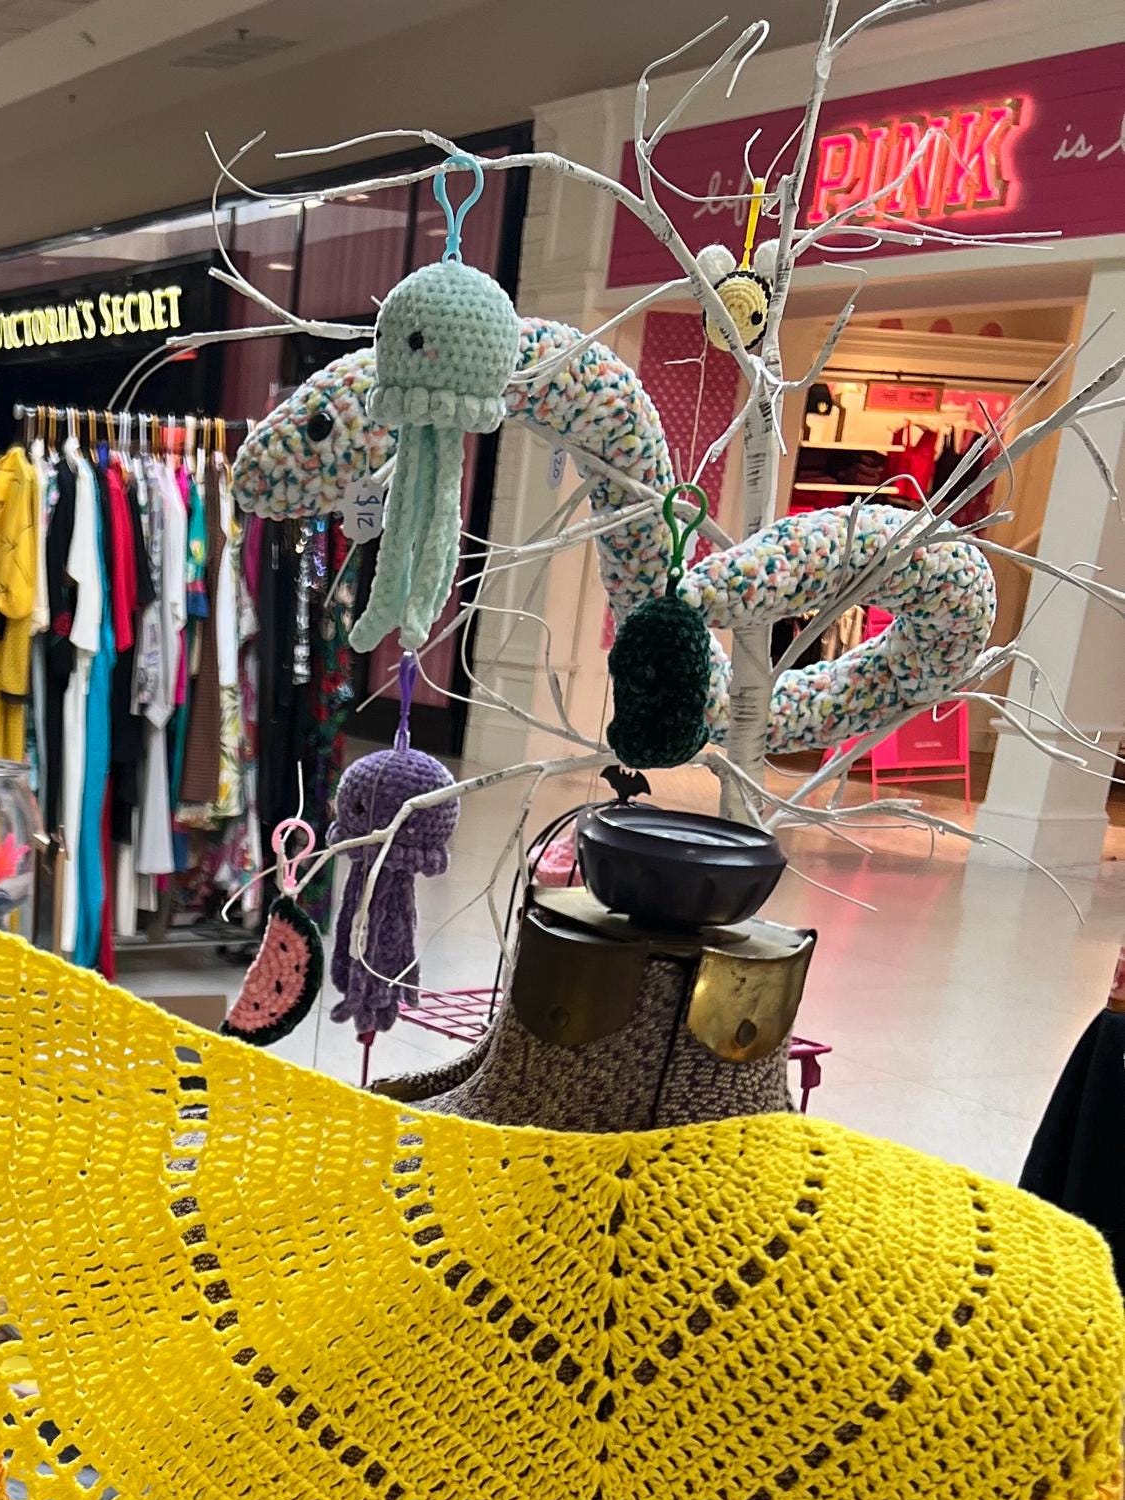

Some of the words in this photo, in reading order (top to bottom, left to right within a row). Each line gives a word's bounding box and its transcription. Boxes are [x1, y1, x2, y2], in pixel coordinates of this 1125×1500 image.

[693, 168, 756, 226] lif
[807, 99, 1025, 224] PINK
[1053, 124, 1093, 161] is
[98, 285, 182, 337] SECRET
[353, 495, 381, 529] $12
